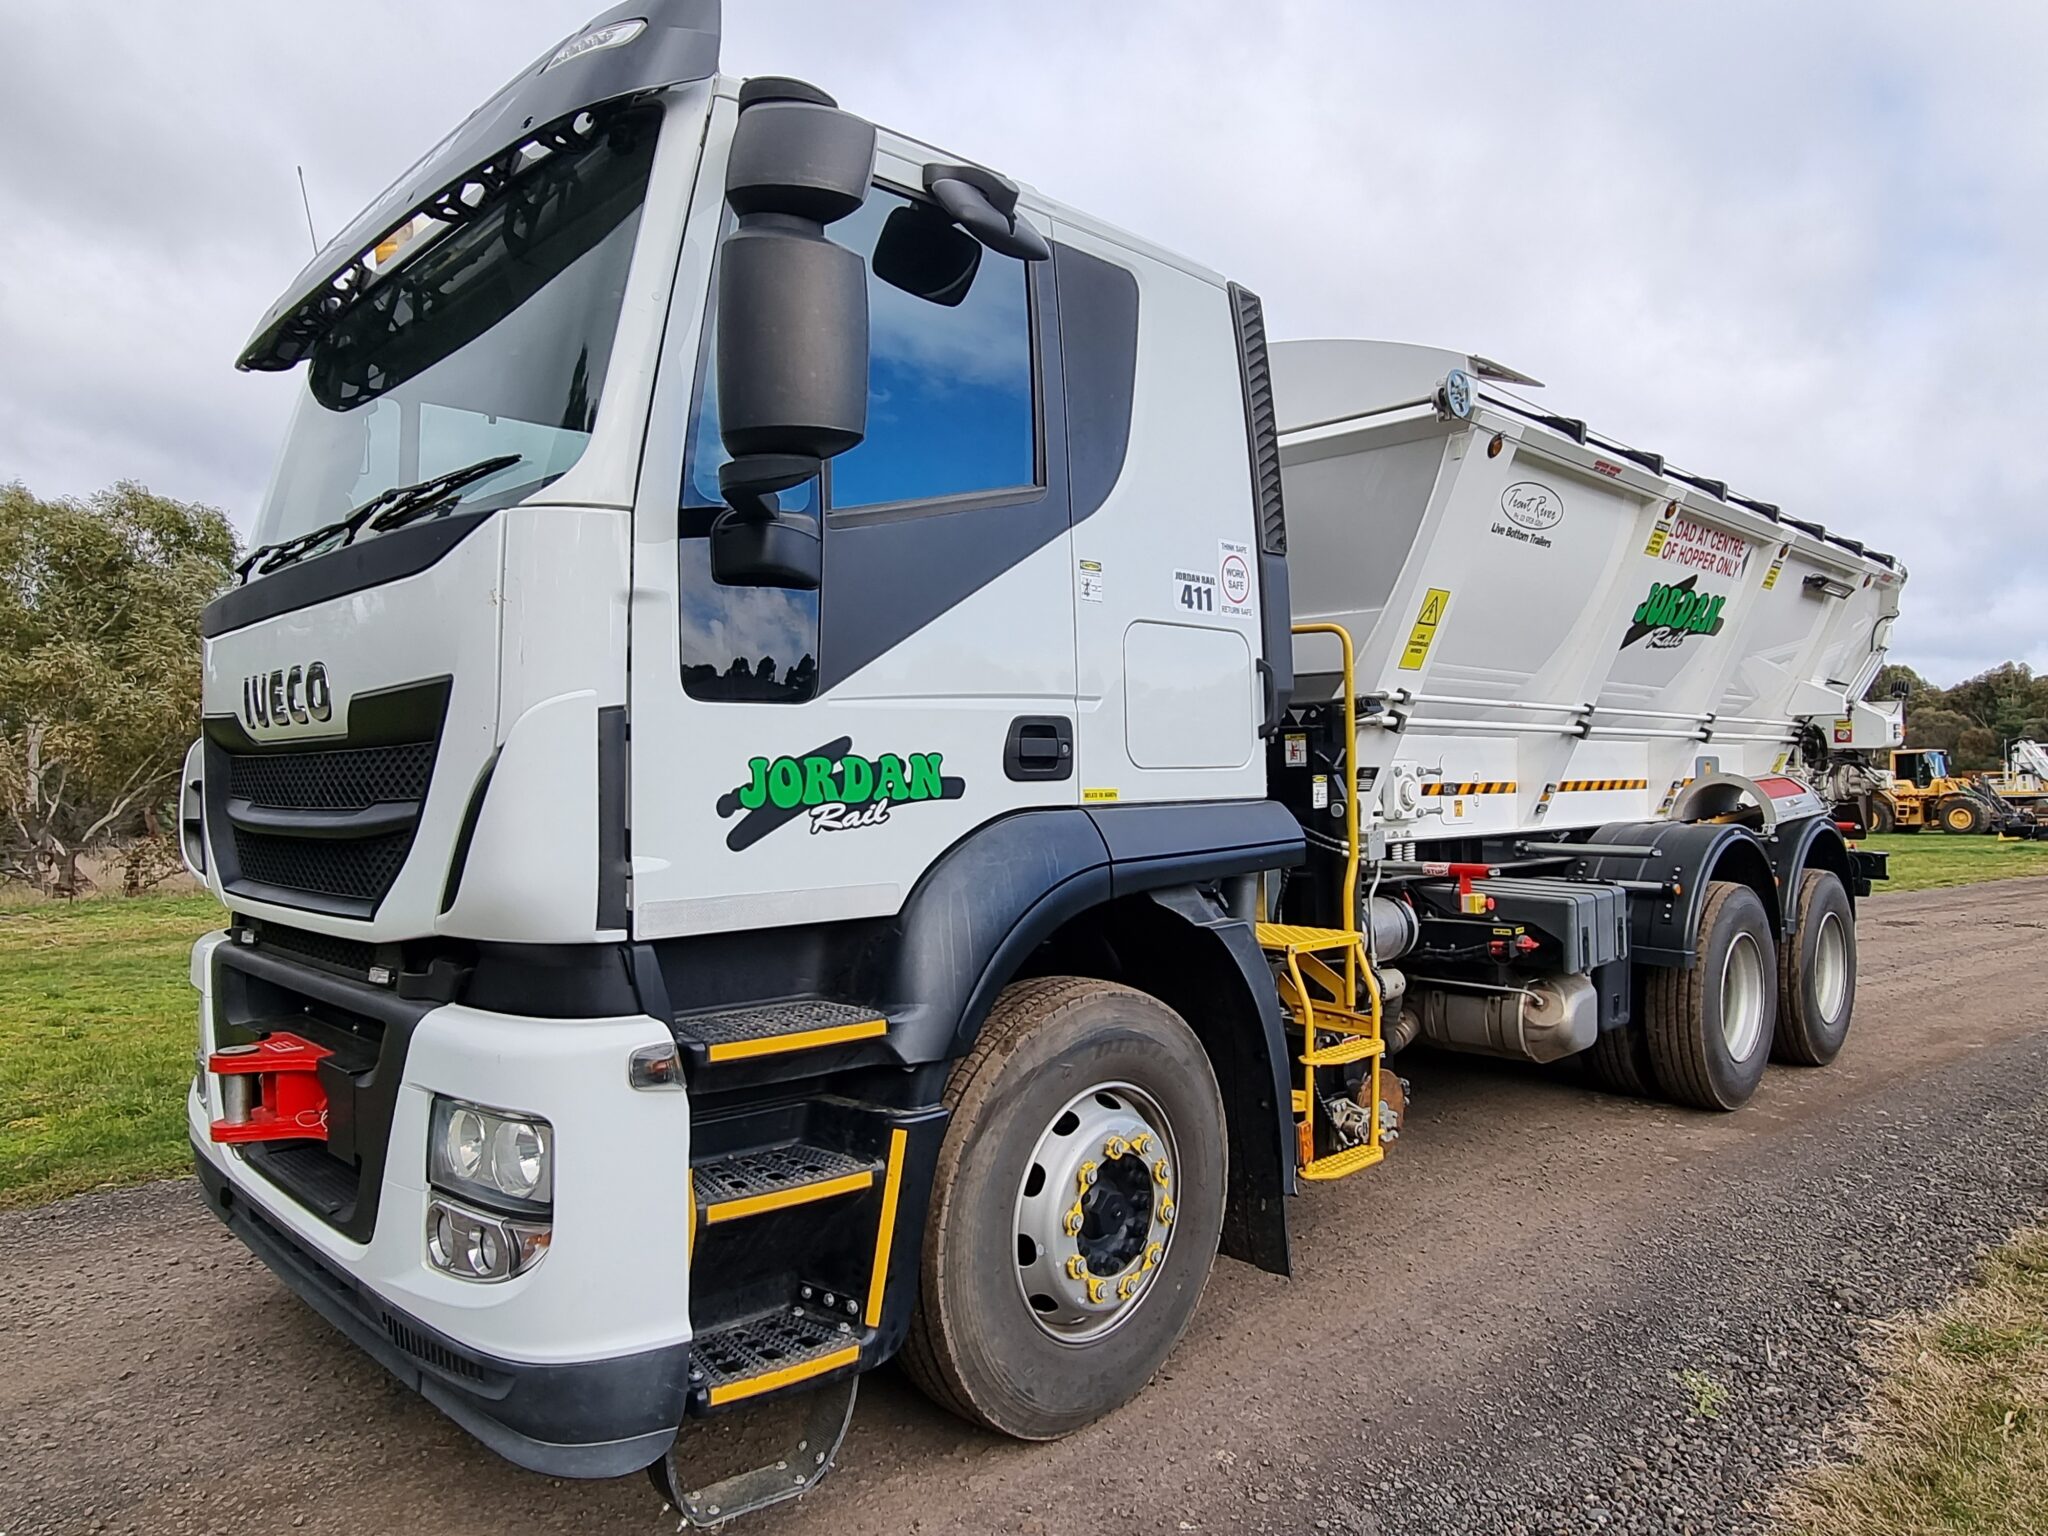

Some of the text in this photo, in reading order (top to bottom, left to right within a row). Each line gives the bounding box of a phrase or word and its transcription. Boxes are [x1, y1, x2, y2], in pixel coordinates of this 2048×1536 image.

[1508, 488, 1537, 512] Trout
[1534, 495, 1556, 520] River
[1221, 543, 1247, 554] THINK SAFE
[1491, 522, 1552, 549] Live Bottom Trailers
[1669, 520, 1697, 542] LOAD
[1697, 527, 1711, 547] AT
[1711, 532, 1746, 558] CENTRE
[1662, 541, 1678, 561] OF
[1677, 545, 1716, 571] HOPPER
[1716, 557, 1740, 578] ONLY
[1175, 571, 1215, 585] JORDAN RAIL
[1226, 568, 1245, 579] WORK
[1228, 580, 1244, 591] SAFE
[1181, 584, 1212, 611] 411
[1221, 605, 1253, 617] RETURN SAFE
[1633, 582, 1726, 633] JORDAN
[1645, 626, 1689, 649] Rail
[243, 660, 332, 730] IVECO
[738, 753, 943, 810] JORDAN
[810, 798, 890, 835] Rail
